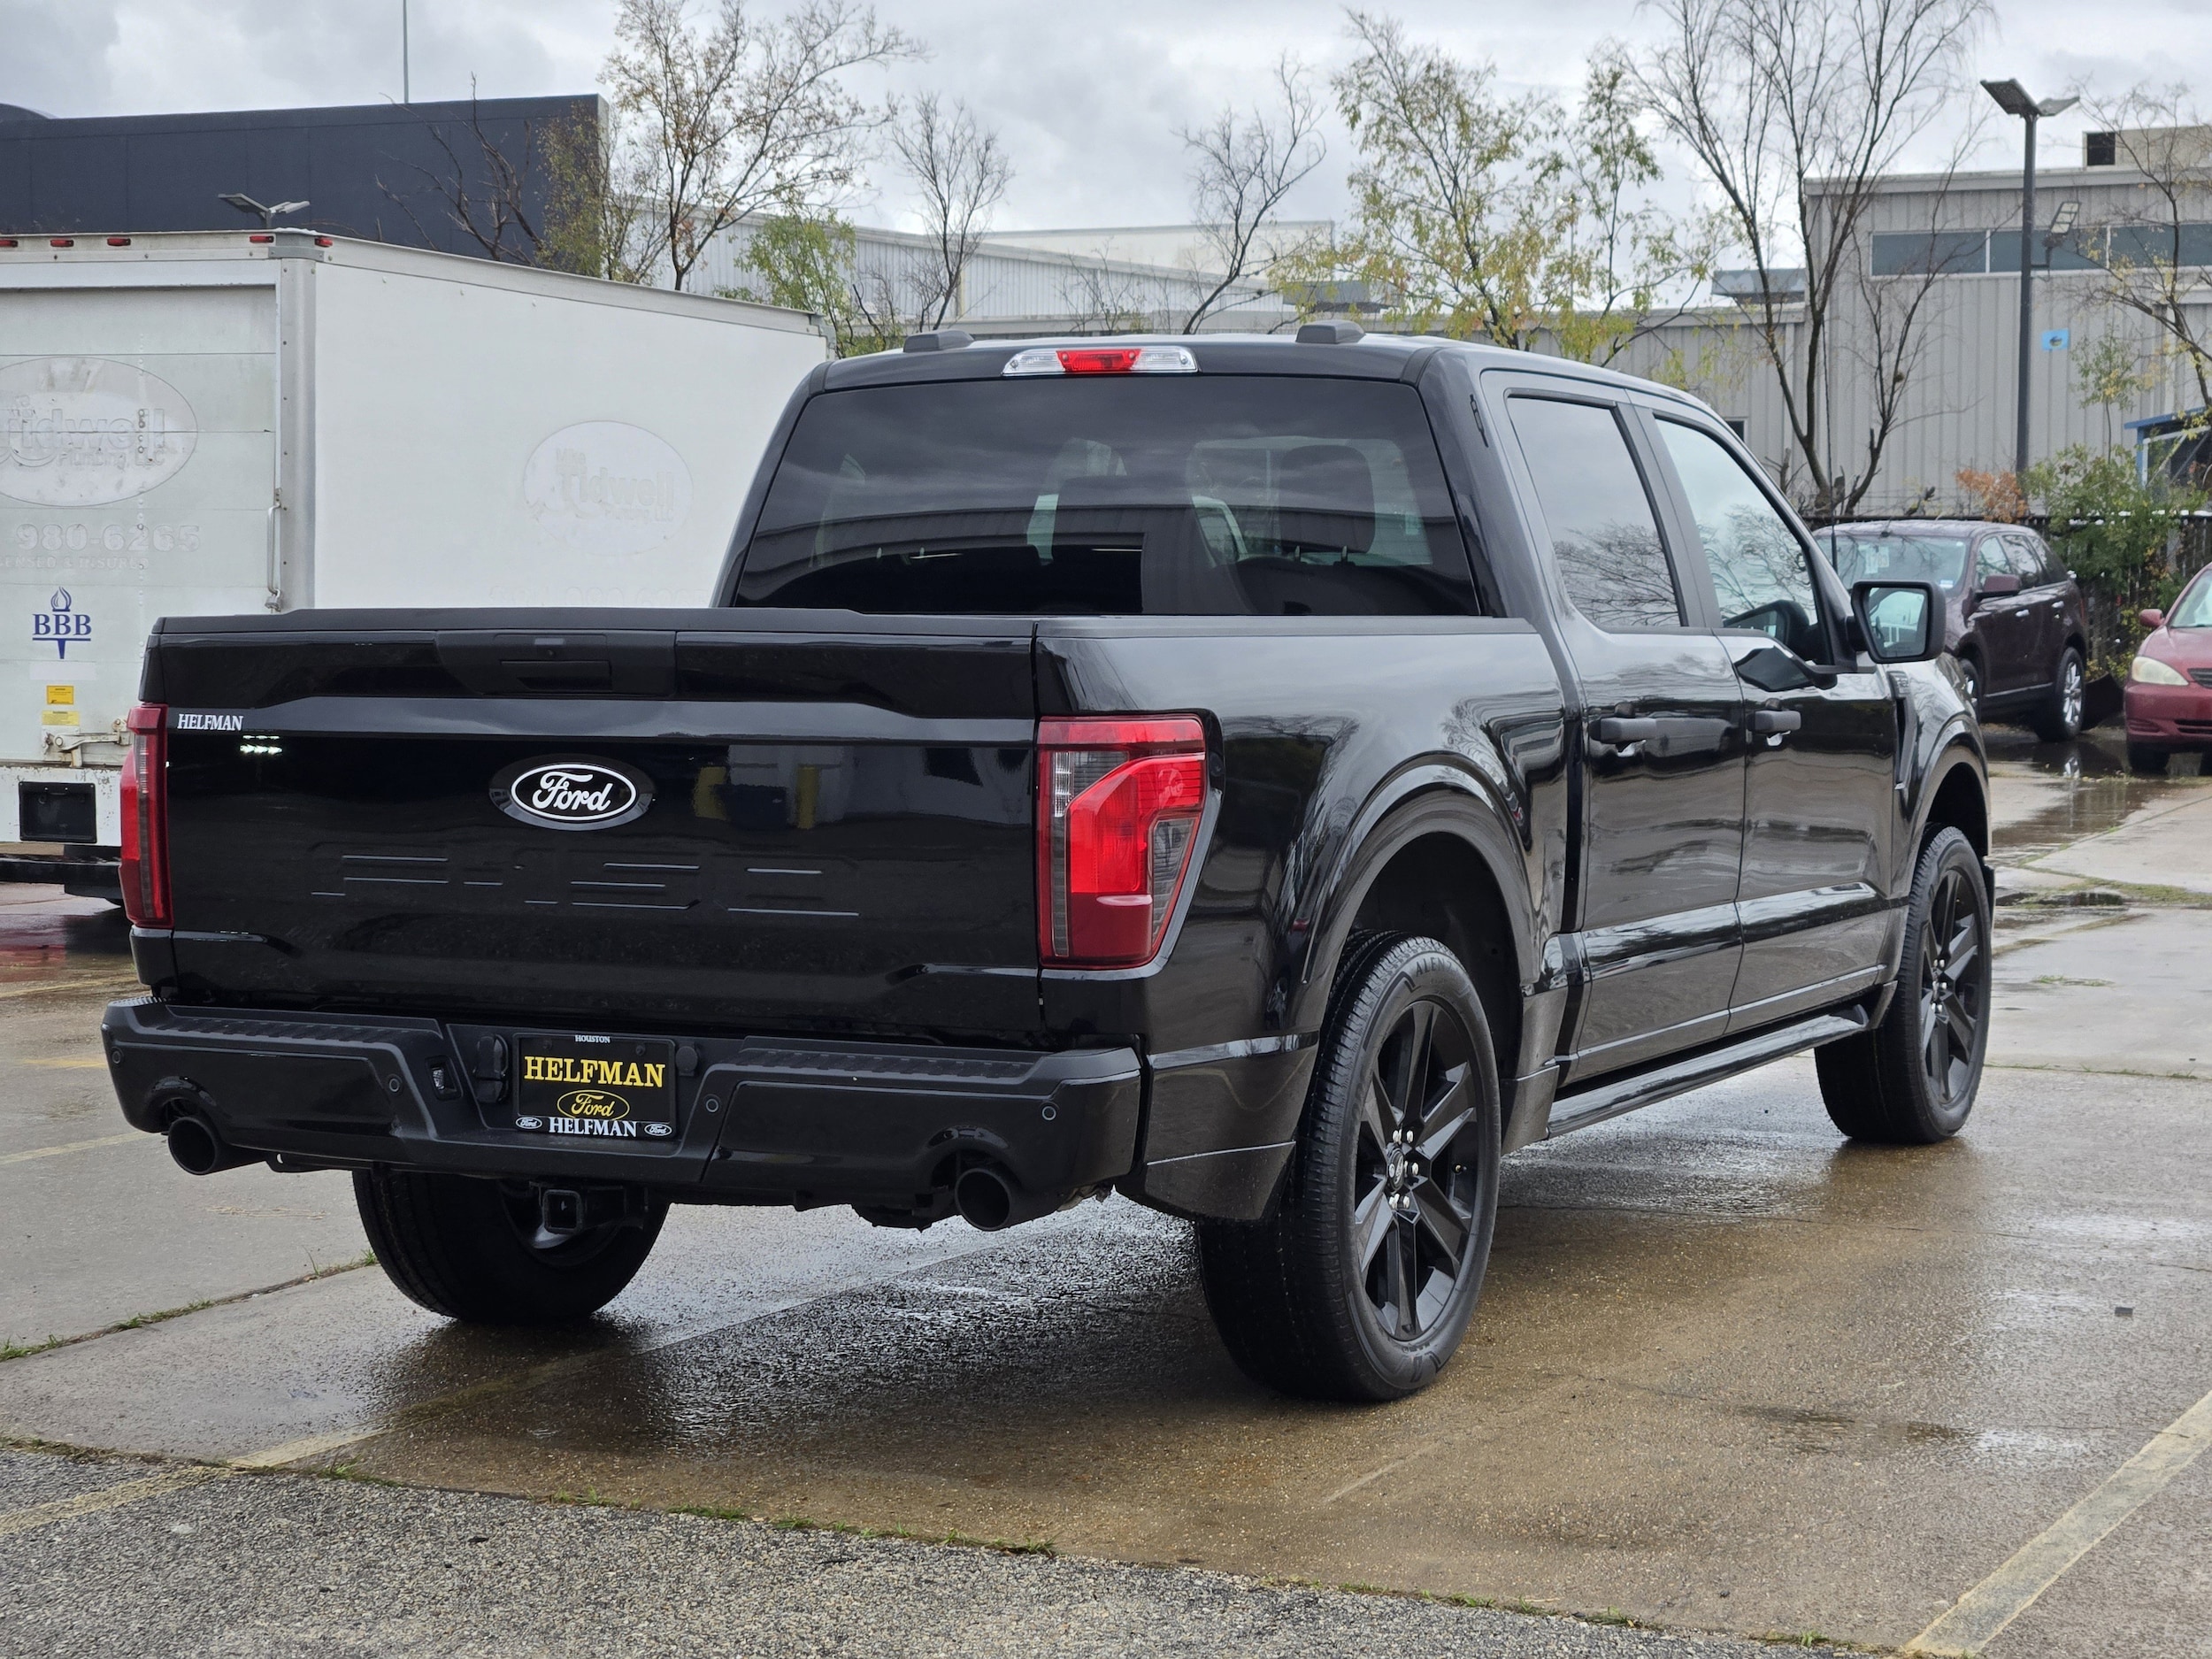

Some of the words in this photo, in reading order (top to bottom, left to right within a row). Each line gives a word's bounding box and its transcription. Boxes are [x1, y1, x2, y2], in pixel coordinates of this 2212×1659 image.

[16, 523, 201, 552] 980-6265
[32, 613, 92, 635] BBB
[177, 713, 243, 731] HELFMAN
[532, 771, 613, 810] Ford
[574, 1034, 611, 1043] HOUSTON
[524, 1056, 665, 1087] HELFMAN
[571, 1093, 616, 1118] Ford
[548, 1117, 638, 1137] HELFMAN
